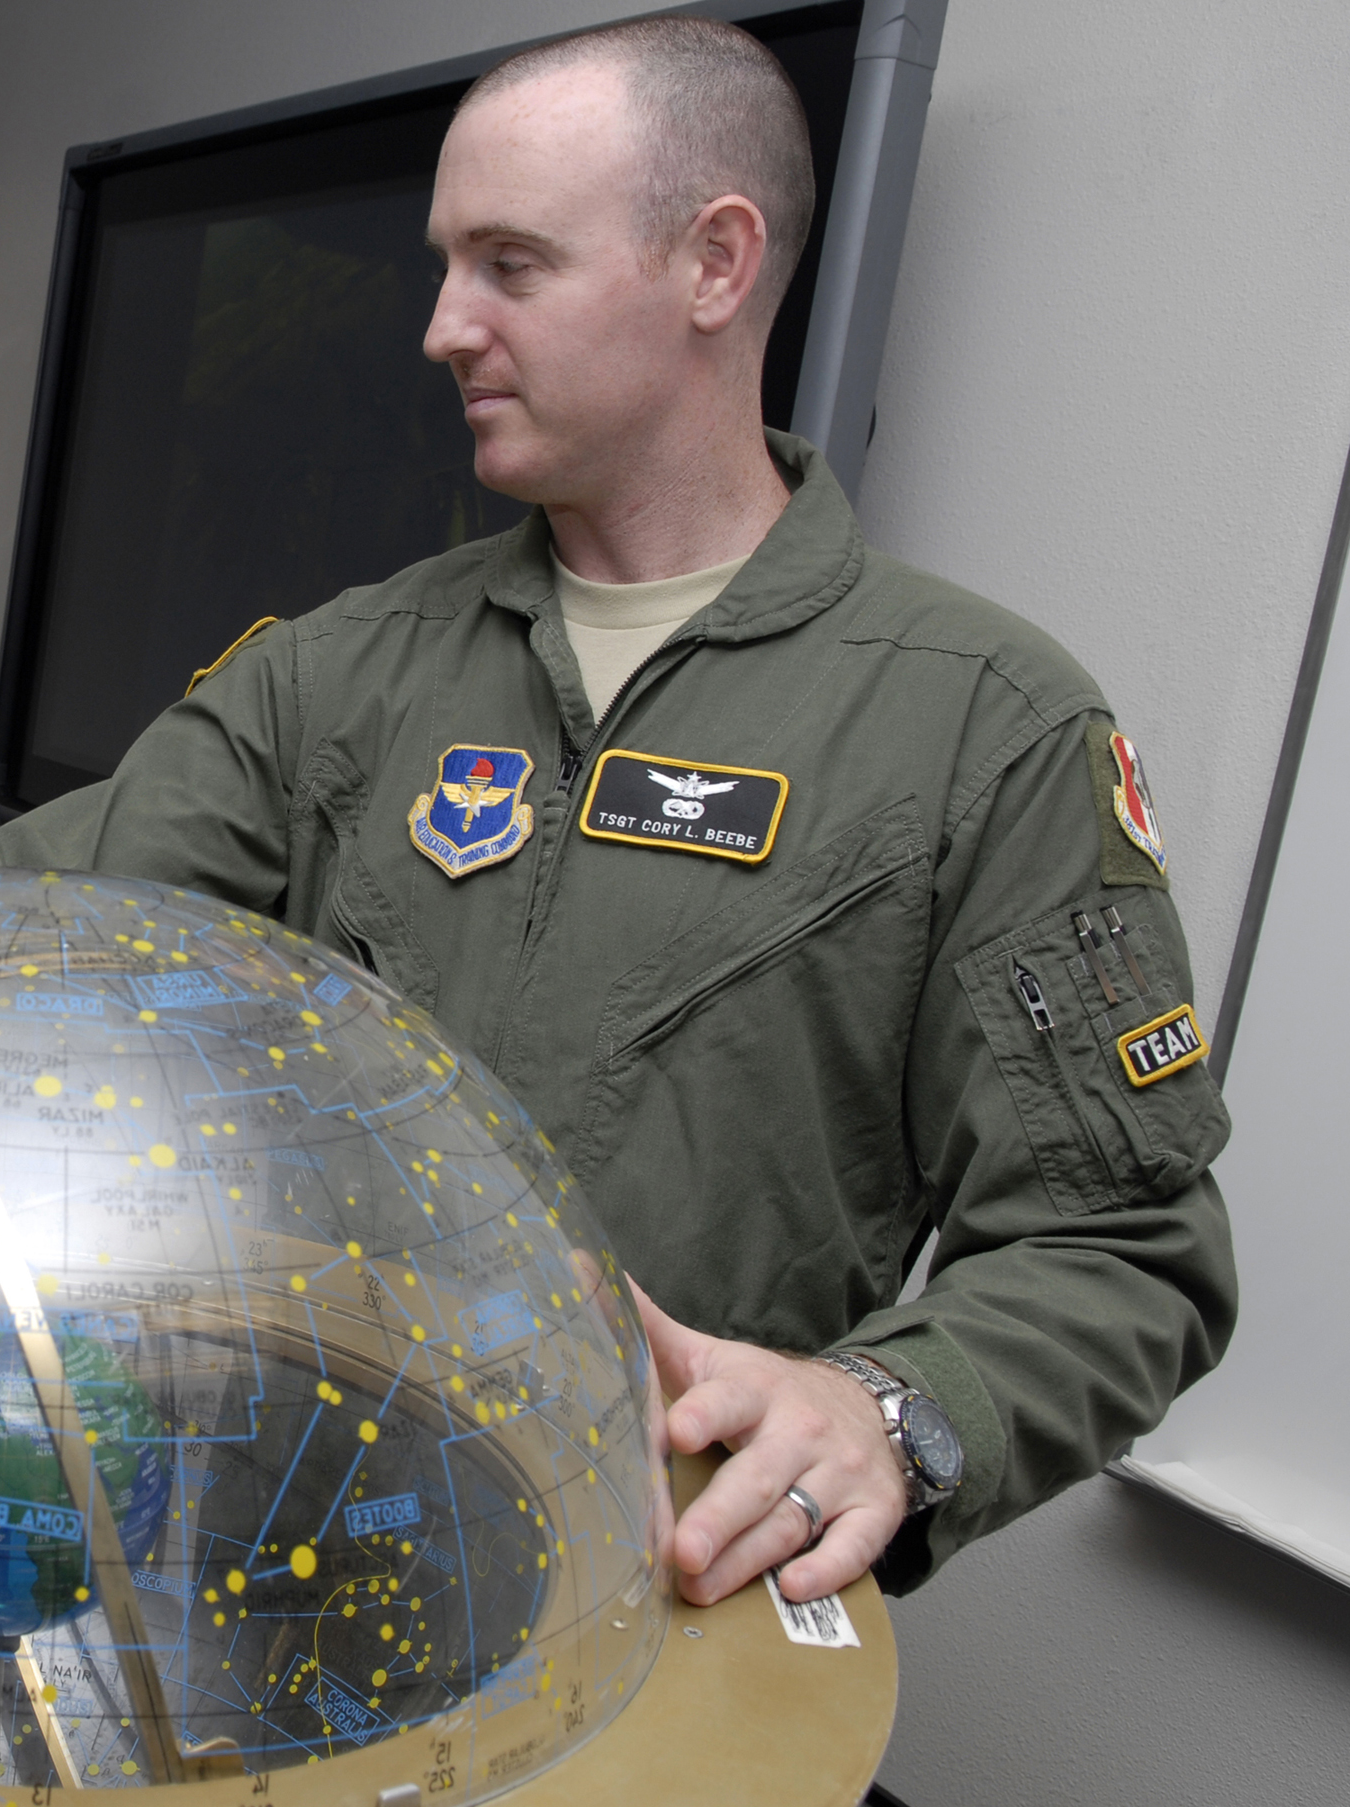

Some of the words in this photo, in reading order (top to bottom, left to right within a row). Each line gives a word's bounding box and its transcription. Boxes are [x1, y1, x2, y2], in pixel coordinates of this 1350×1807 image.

[418, 827, 452, 862] EDUCATION
[458, 844, 489, 868] TRAINING
[491, 824, 520, 856] COMMAND
[599, 812, 636, 828] TSGT
[641, 819, 682, 835] CORY
[685, 825, 698, 838] L.
[704, 828, 757, 849] BEEBE
[1127, 1016, 1199, 1072] TEAM
[362, 1291, 387, 1311] 330°
[395, 1527, 454, 1570] SAGITTARIUS
[308, 1693, 369, 1742] AUSTRALIS
[327, 1689, 369, 1727] CORONA
